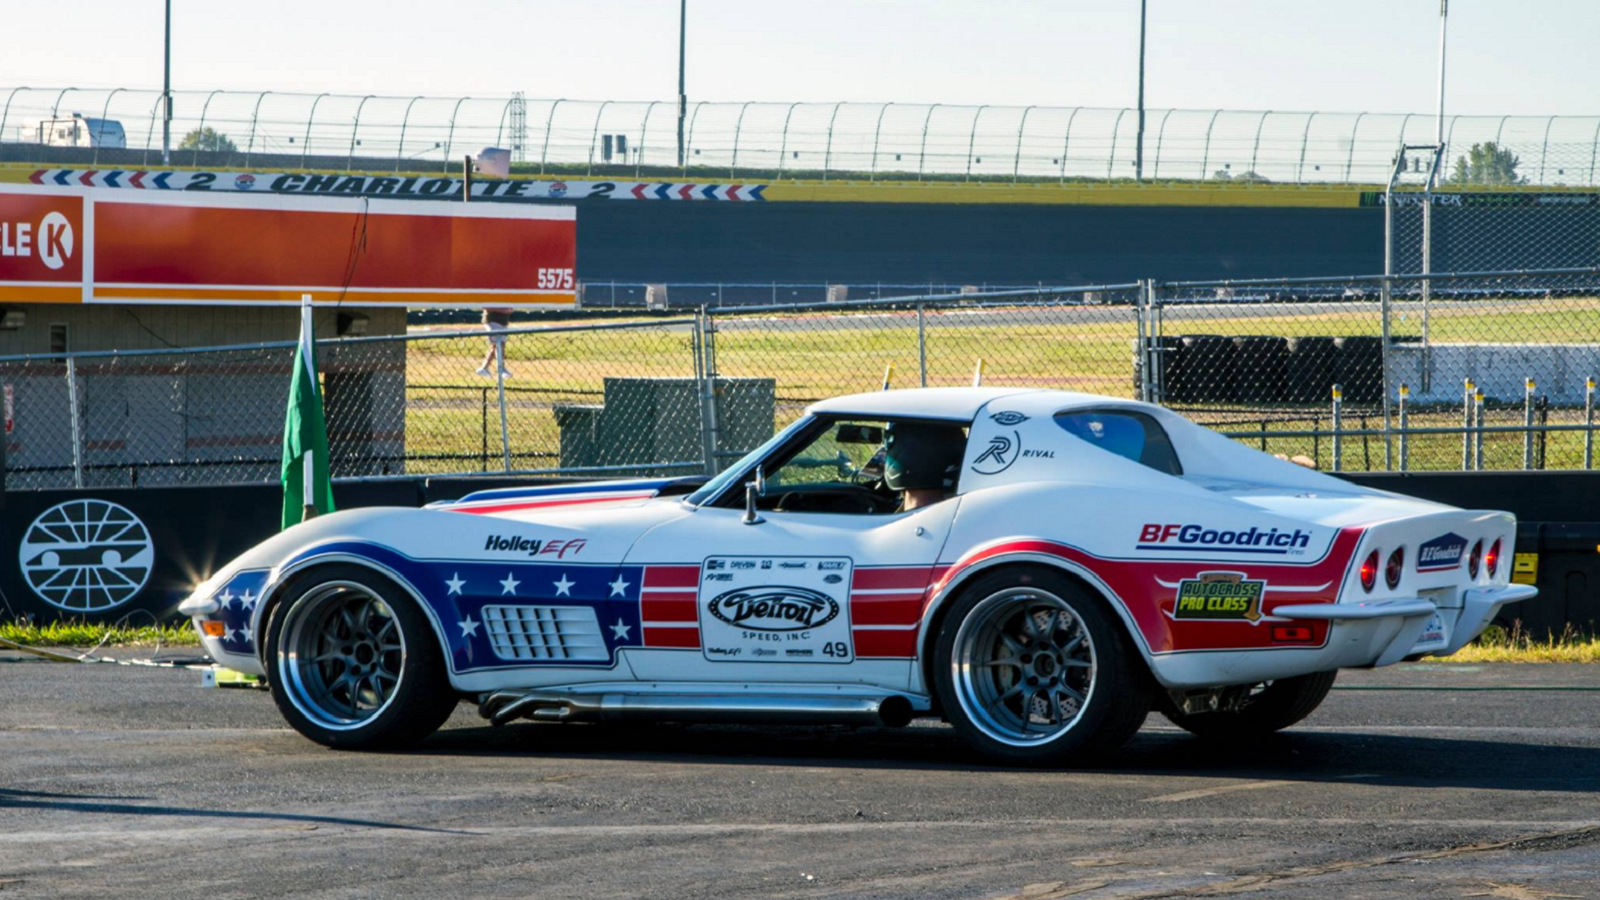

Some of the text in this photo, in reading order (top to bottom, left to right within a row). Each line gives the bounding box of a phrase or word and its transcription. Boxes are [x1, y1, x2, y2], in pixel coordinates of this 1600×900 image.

[185, 173, 616, 198] 2 CHARLOTTE 2
[0, 220, 71, 266] LE K
[537, 267, 574, 289] 5575
[1022, 449, 1055, 459] RIVAL
[1138, 523, 1311, 548] BFGoodrich
[485, 535, 588, 559] Holley EFI
[1183, 582, 1259, 596] AUTOCROSS
[1179, 597, 1248, 610] PRO CLASS
[822, 641, 849, 658] 49
